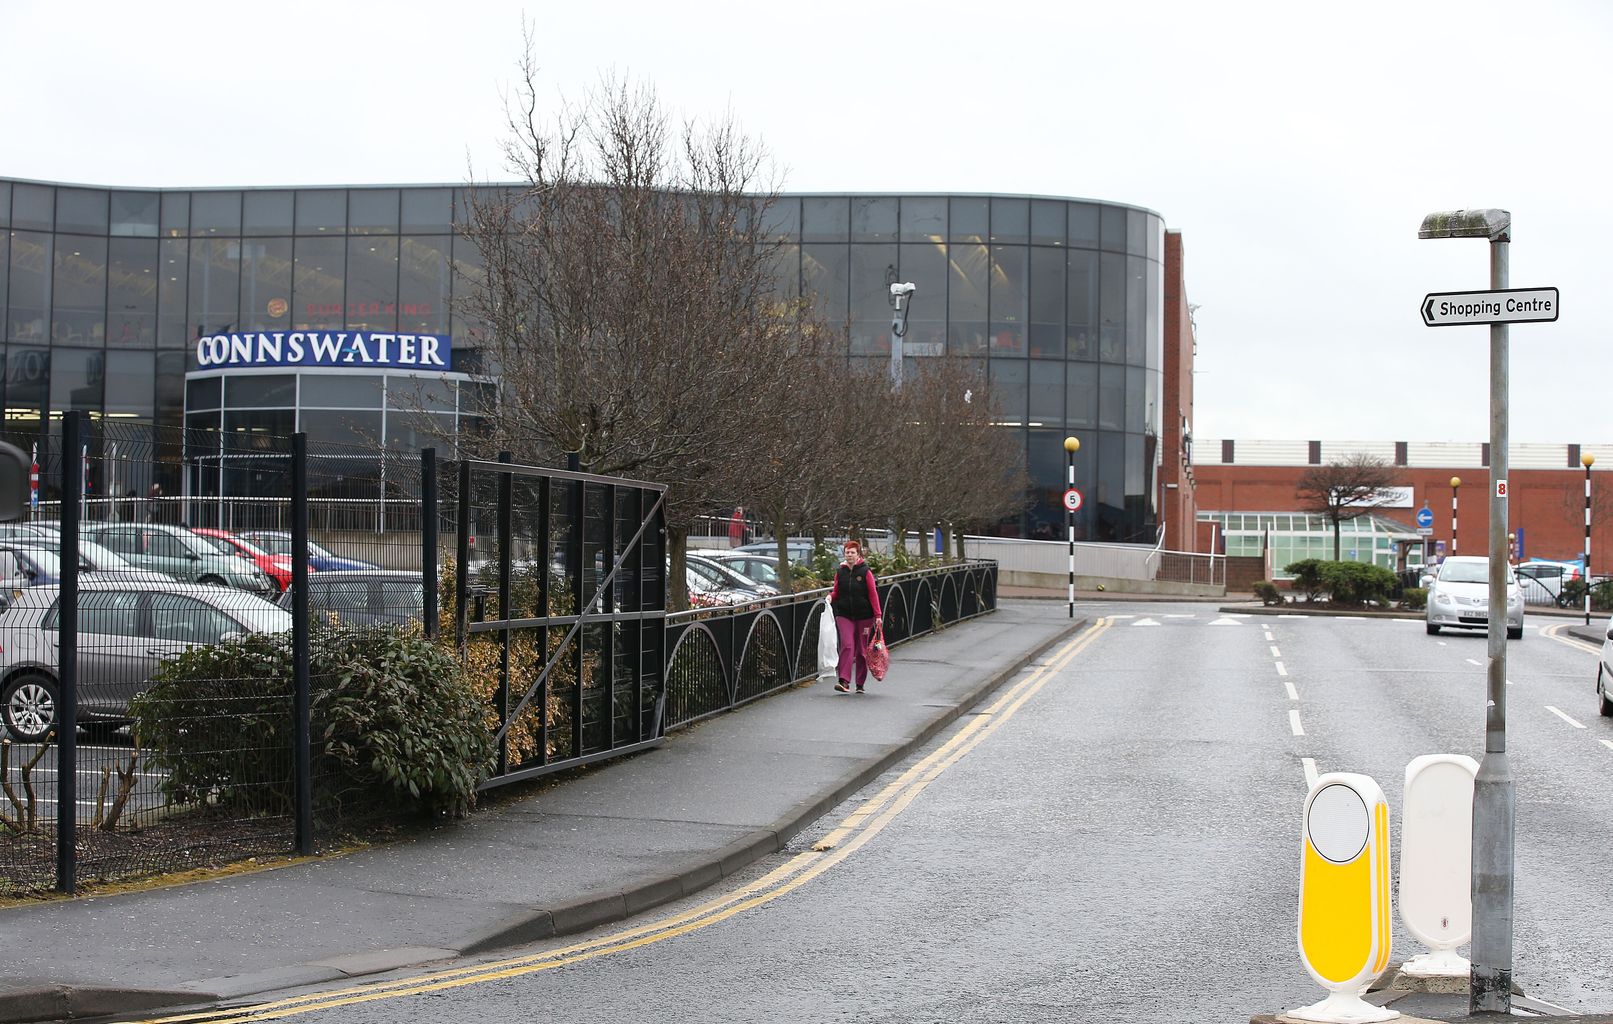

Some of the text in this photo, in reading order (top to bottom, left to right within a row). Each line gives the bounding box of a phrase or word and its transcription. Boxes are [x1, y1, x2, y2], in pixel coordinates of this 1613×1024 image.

[1440, 298, 1551, 317] Shopping Centre
[197, 332, 445, 366] CONNSWATER
[1498, 483, 1506, 495] 8
[1070, 495, 1076, 505] 5
